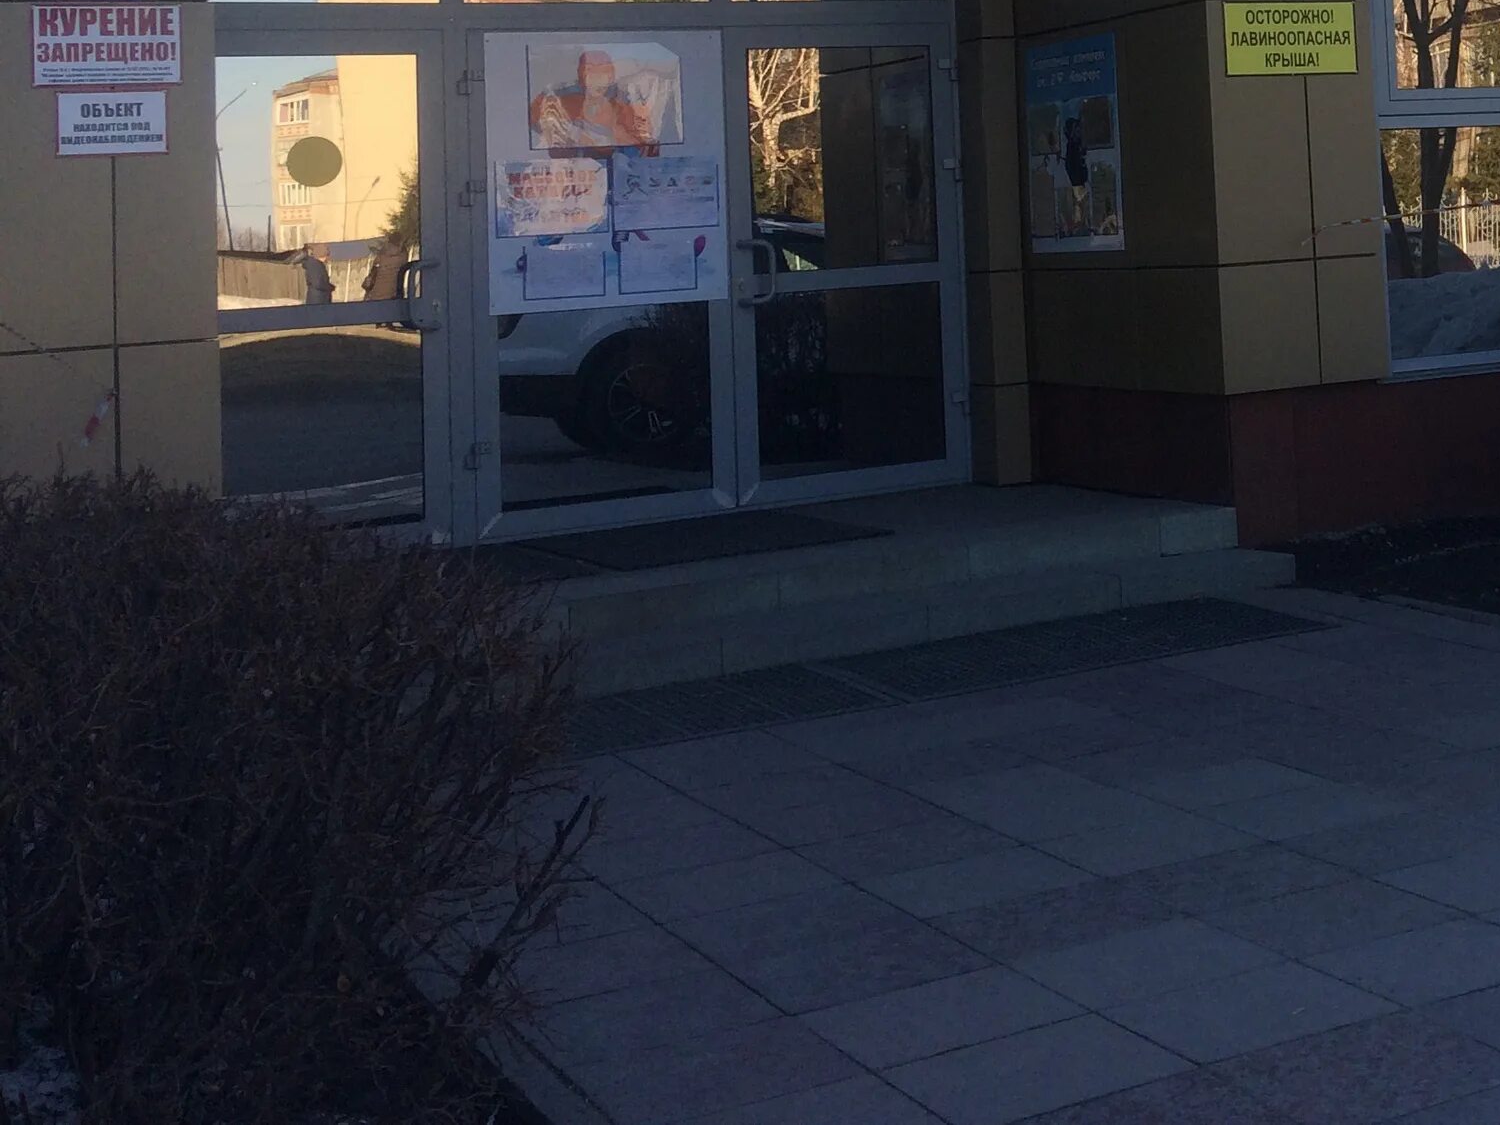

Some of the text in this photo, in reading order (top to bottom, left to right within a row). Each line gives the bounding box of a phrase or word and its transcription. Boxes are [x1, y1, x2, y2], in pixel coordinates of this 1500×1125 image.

[38, 8, 175, 37] КУРЕНИЕ
[1245, 9, 1334, 25] ОСТОРОЖНО!
[1230, 30, 1351, 47] ЛАВИНООПАСНАЯ
[36, 41, 177, 65] ЗАПРЕЩЕНО!
[1265, 52, 1320, 68] КРЫША!
[80, 102, 144, 118] ОБЪЕКТ
[73, 121, 151, 133] НАХОДИТСЯ ПОД
